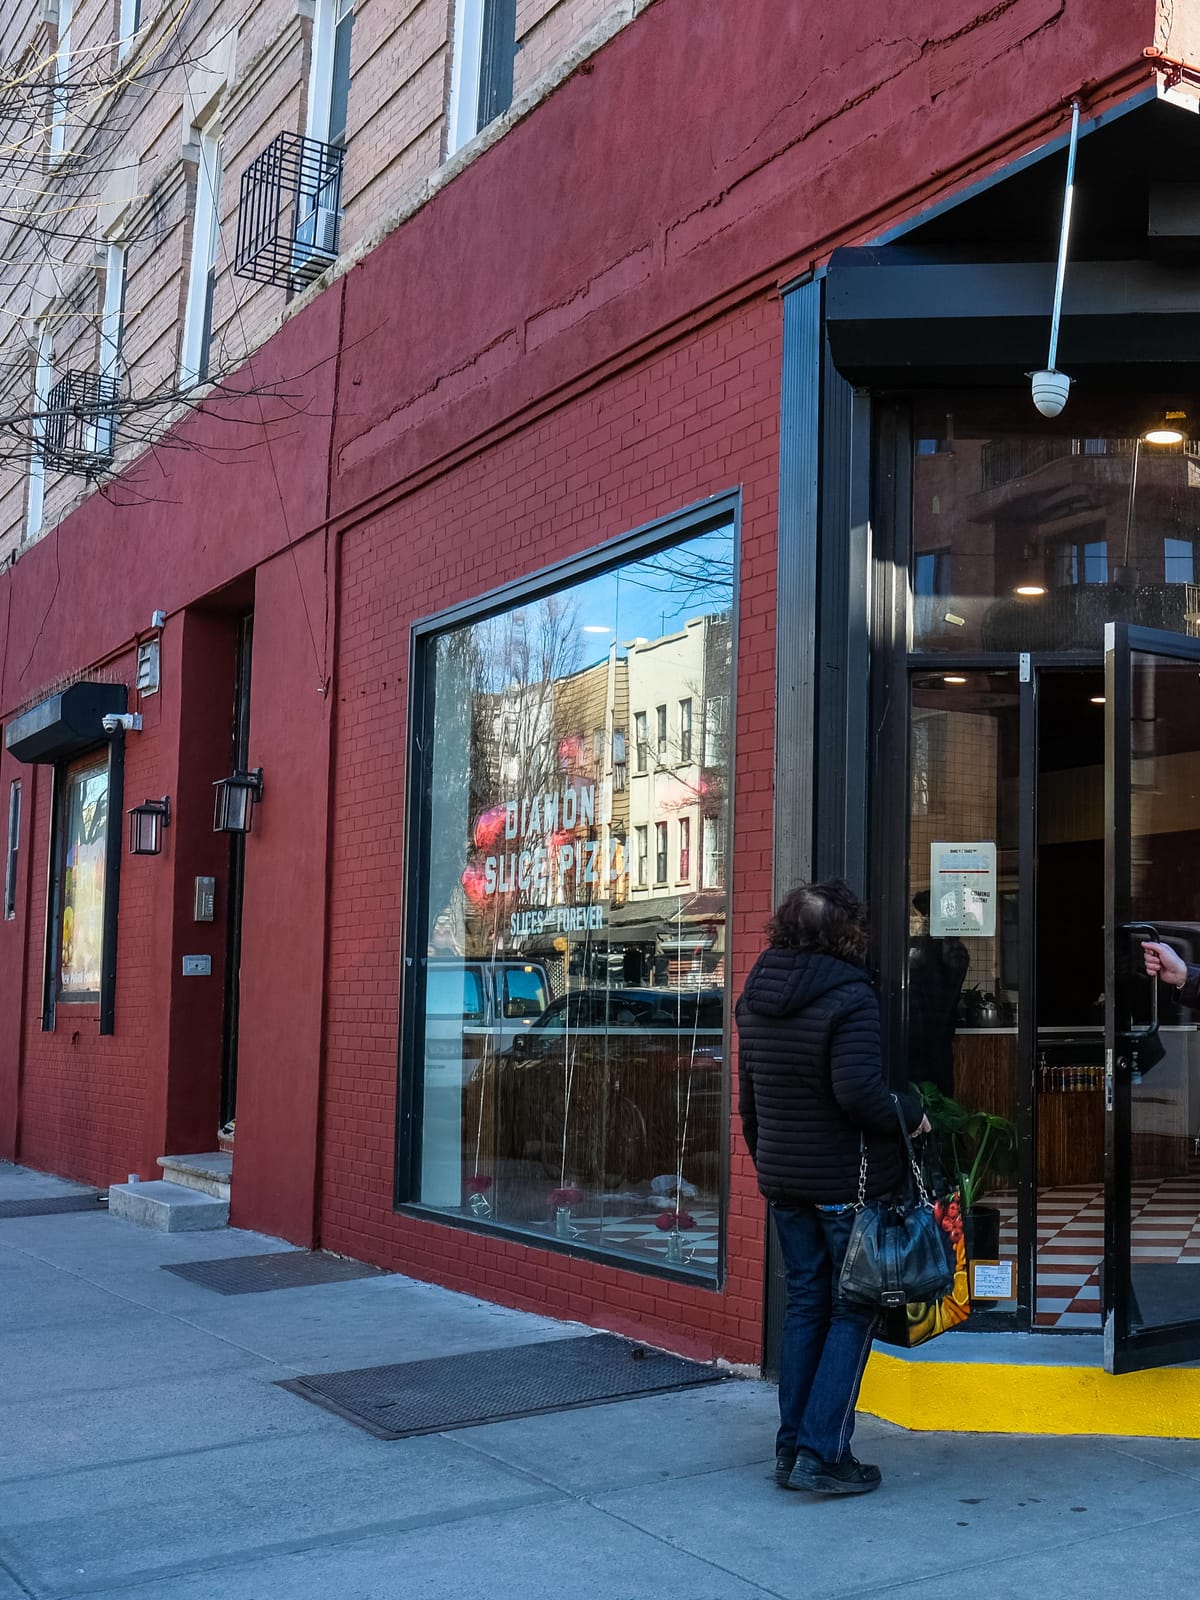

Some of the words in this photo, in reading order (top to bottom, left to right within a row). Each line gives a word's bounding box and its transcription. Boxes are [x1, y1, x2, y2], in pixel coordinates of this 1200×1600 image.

[485, 846, 548, 894] SLICE
[510, 910, 544, 936] SLICES
[557, 905, 603, 932] FOREVER
